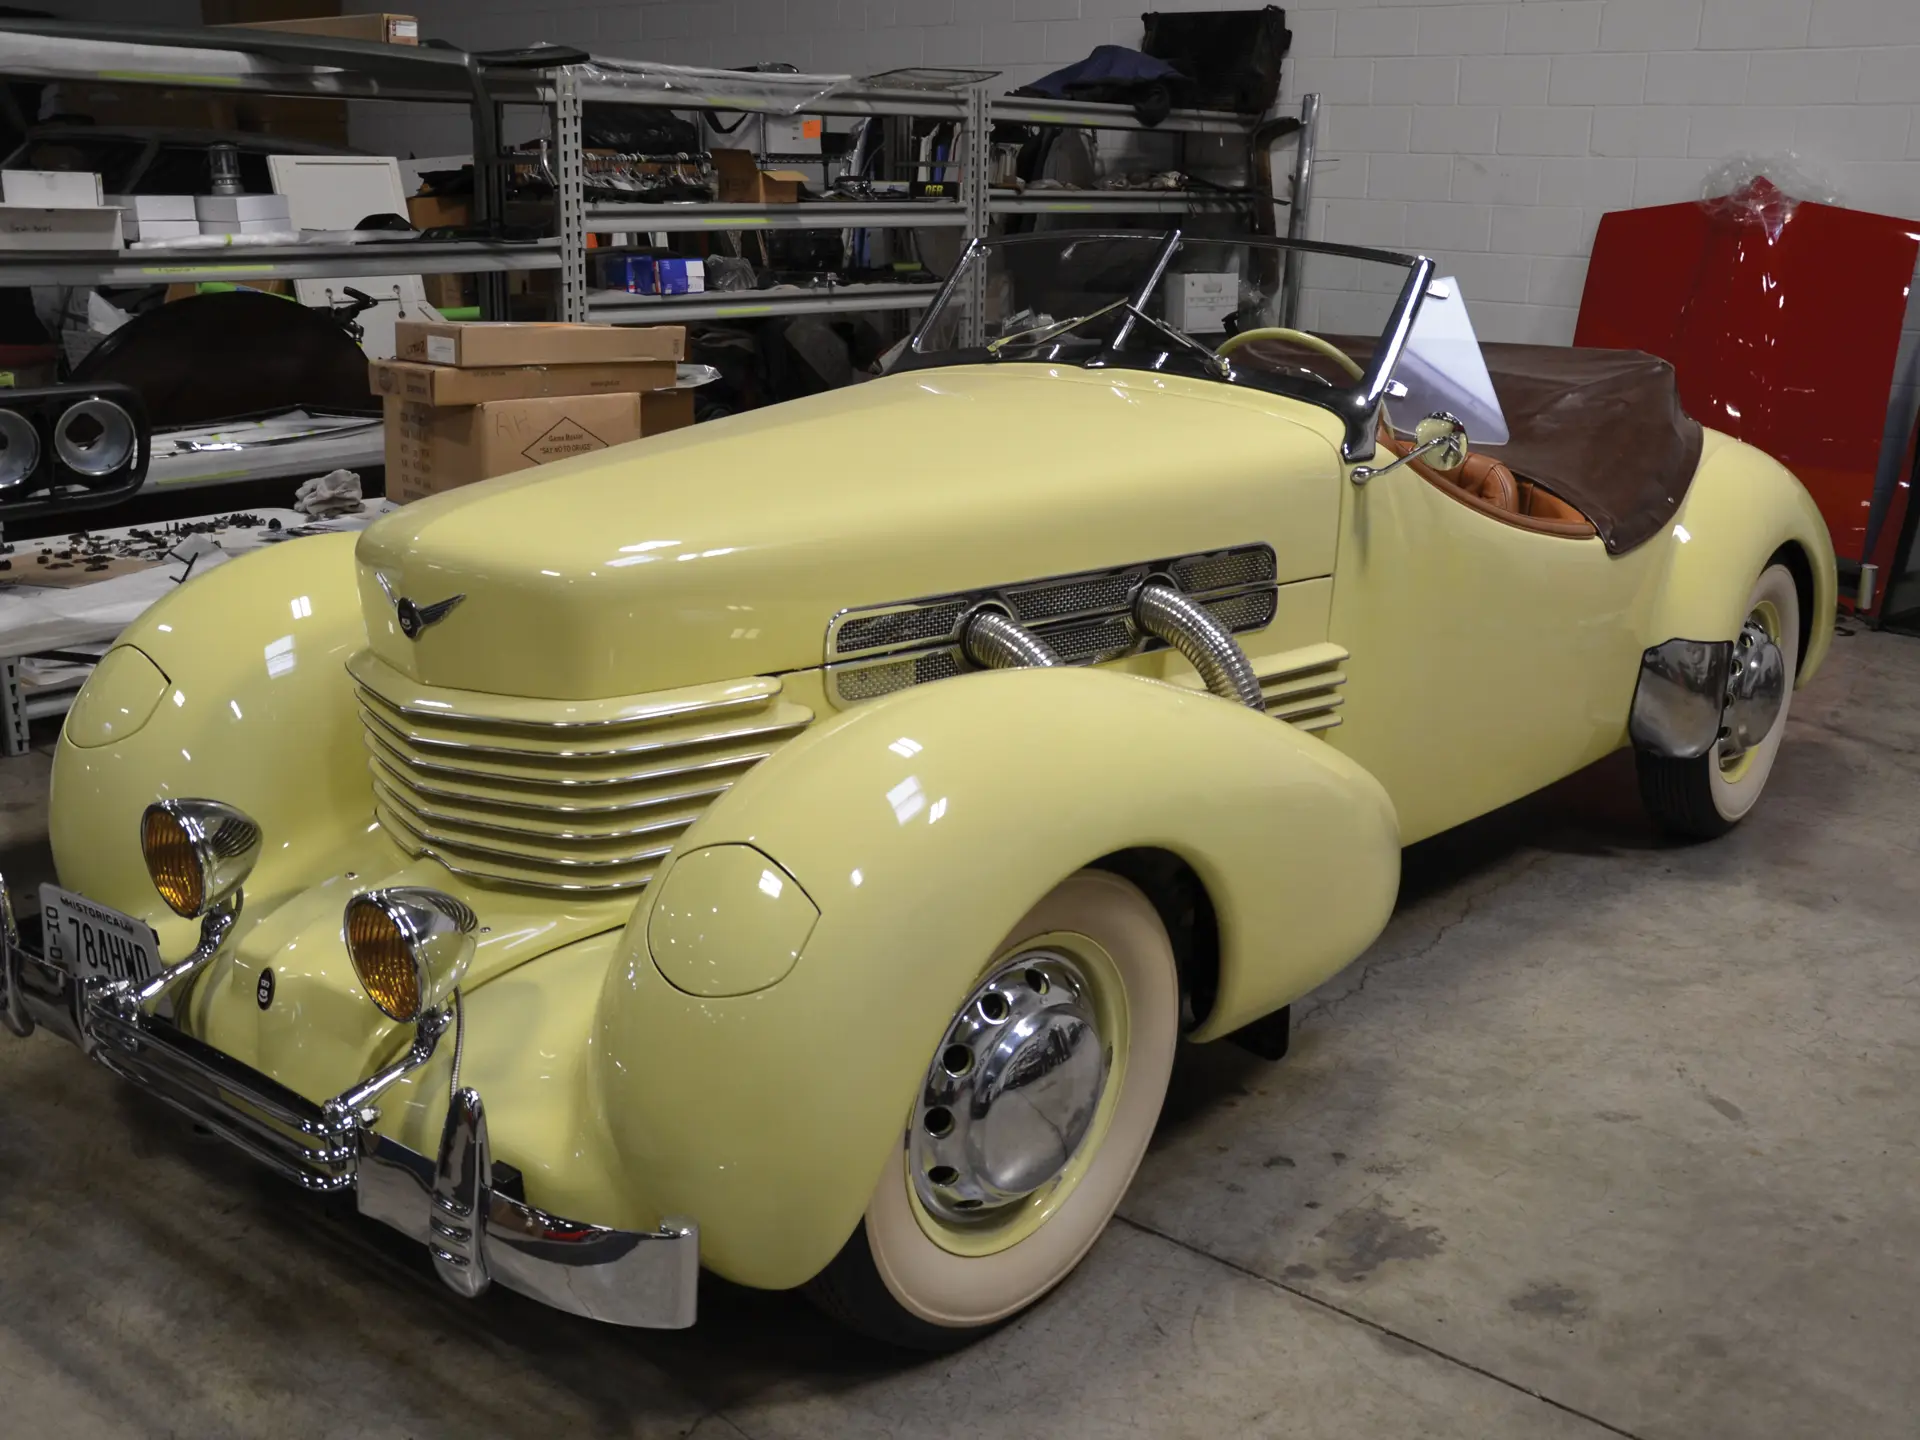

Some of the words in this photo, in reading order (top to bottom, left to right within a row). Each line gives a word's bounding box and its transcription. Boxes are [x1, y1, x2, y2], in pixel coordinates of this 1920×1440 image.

[554, 445, 563, 453] NO
[563, 444, 571, 453] TO
[45, 906, 63, 960] OHIO
[67, 900, 128, 932] HISTORICAL
[68, 916, 151, 984] 784HWD
